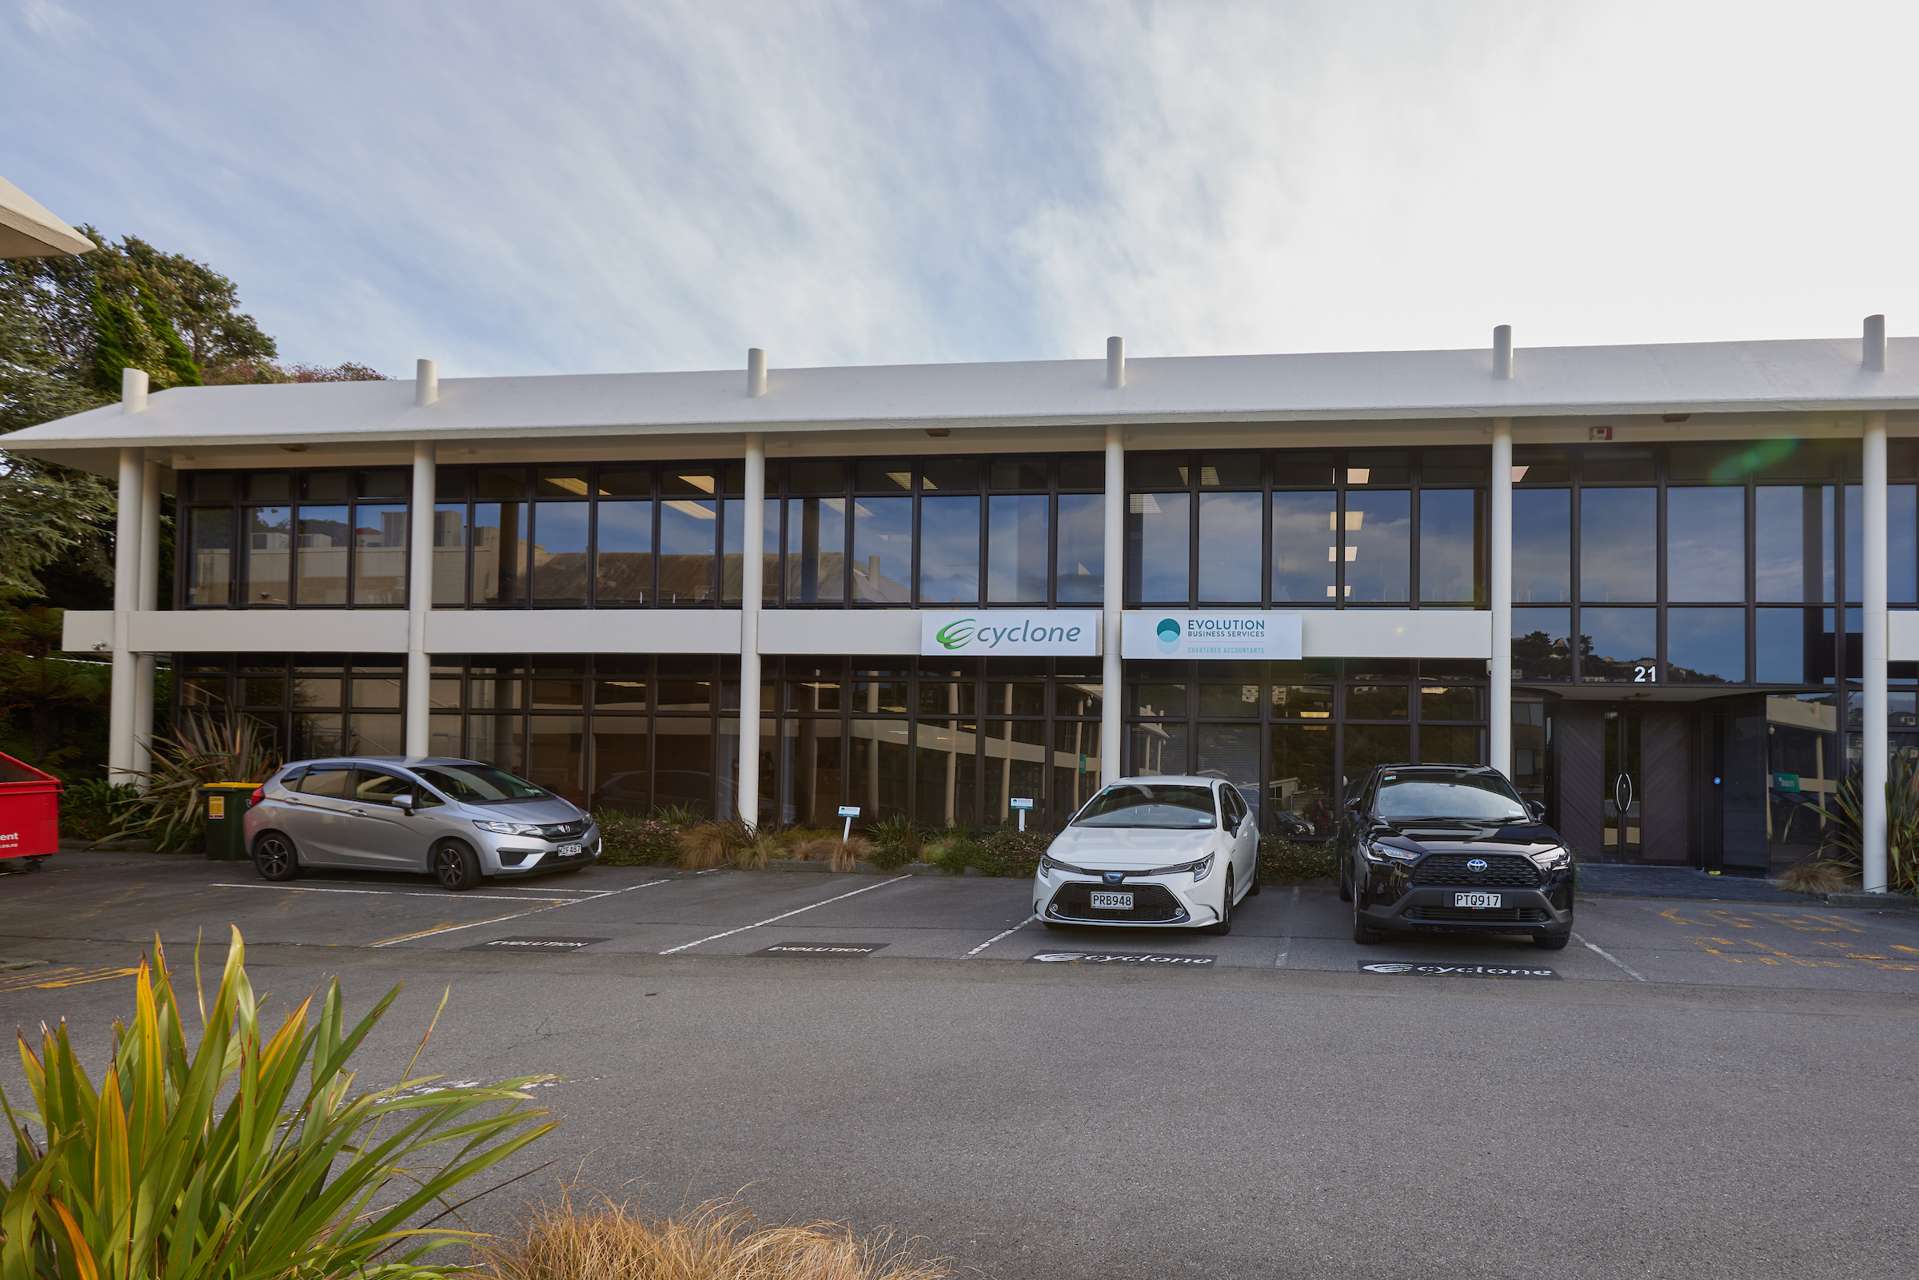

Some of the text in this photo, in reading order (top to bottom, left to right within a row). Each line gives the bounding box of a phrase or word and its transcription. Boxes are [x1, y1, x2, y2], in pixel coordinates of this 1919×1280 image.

[1187, 619, 1265, 630] EVOLUTION
[976, 619, 1082, 649] cyclone
[1187, 630, 1265, 638] BUSINESS SERVICES
[1634, 666, 1656, 682] 21
[1093, 894, 1132, 906] PRB948
[1456, 894, 1499, 906] PTQ917
[1085, 953, 1213, 964] cyclone
[1416, 965, 1553, 976] cyclone
